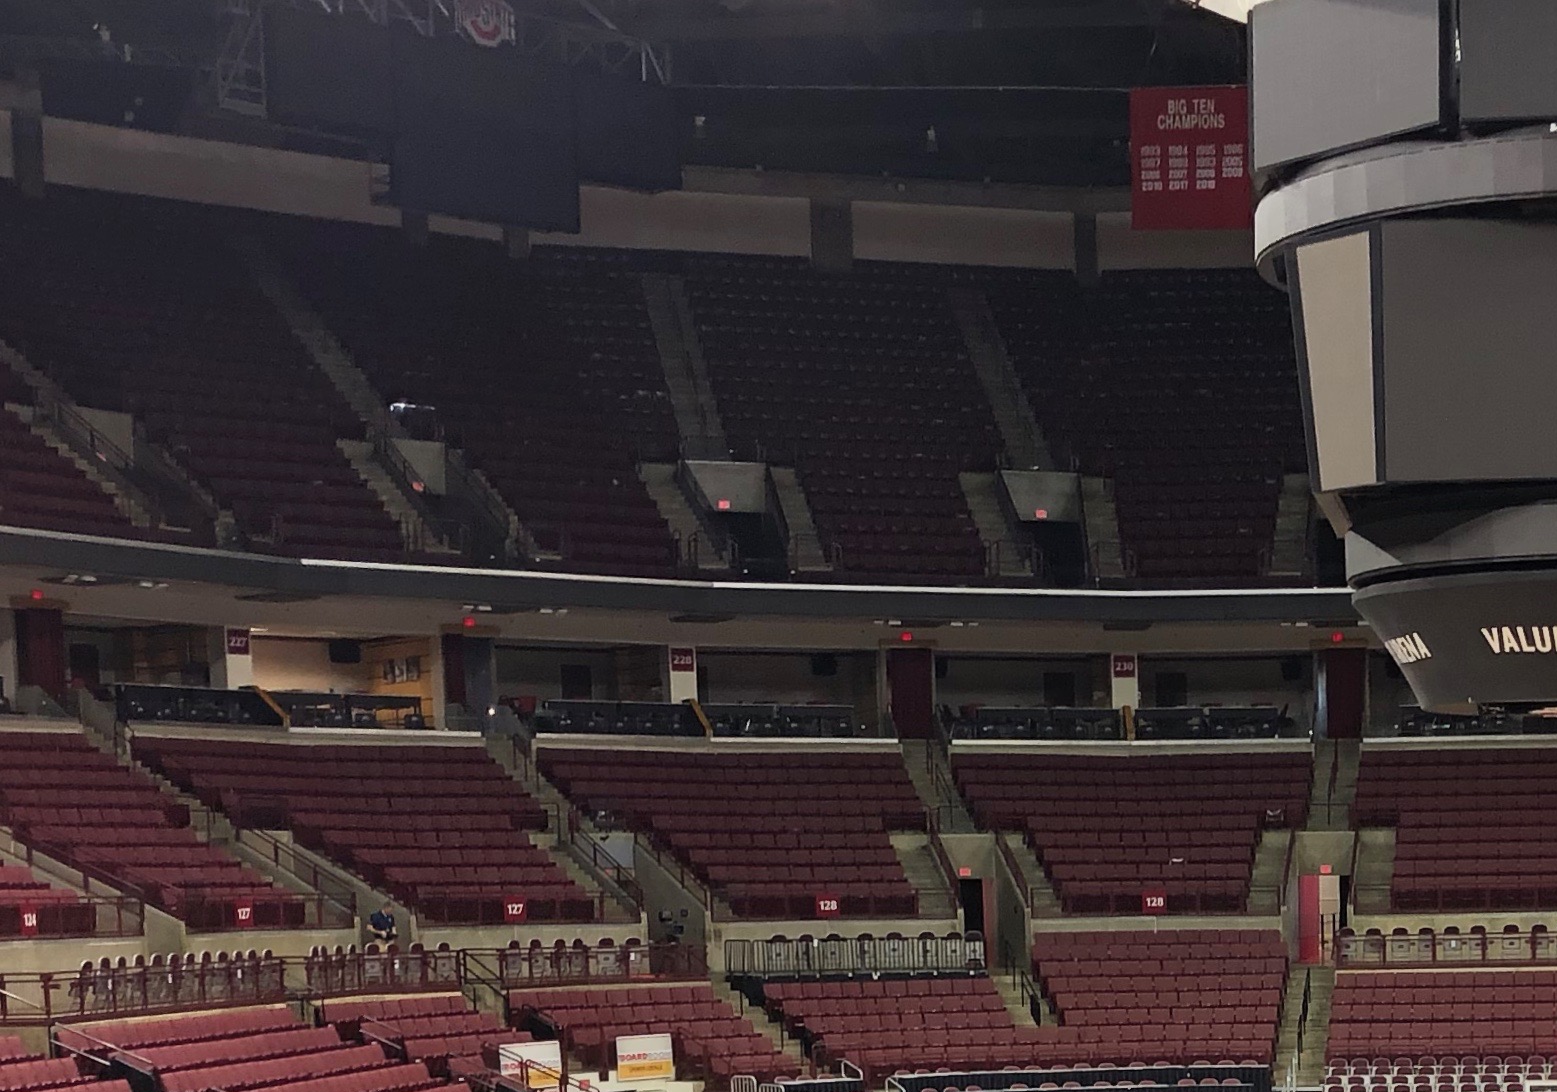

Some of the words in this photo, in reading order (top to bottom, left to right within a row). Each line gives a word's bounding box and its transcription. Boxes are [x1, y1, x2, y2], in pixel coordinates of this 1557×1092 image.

[1168, 99, 1187, 115] BIG
[1192, 98, 1216, 114] TEN
[1158, 113, 1225, 130] CHAMPIONS
[819, 900, 837, 911] 128
[1146, 897, 1164, 907] 128
[237, 907, 251, 920] 127
[507, 903, 524, 915] 127
